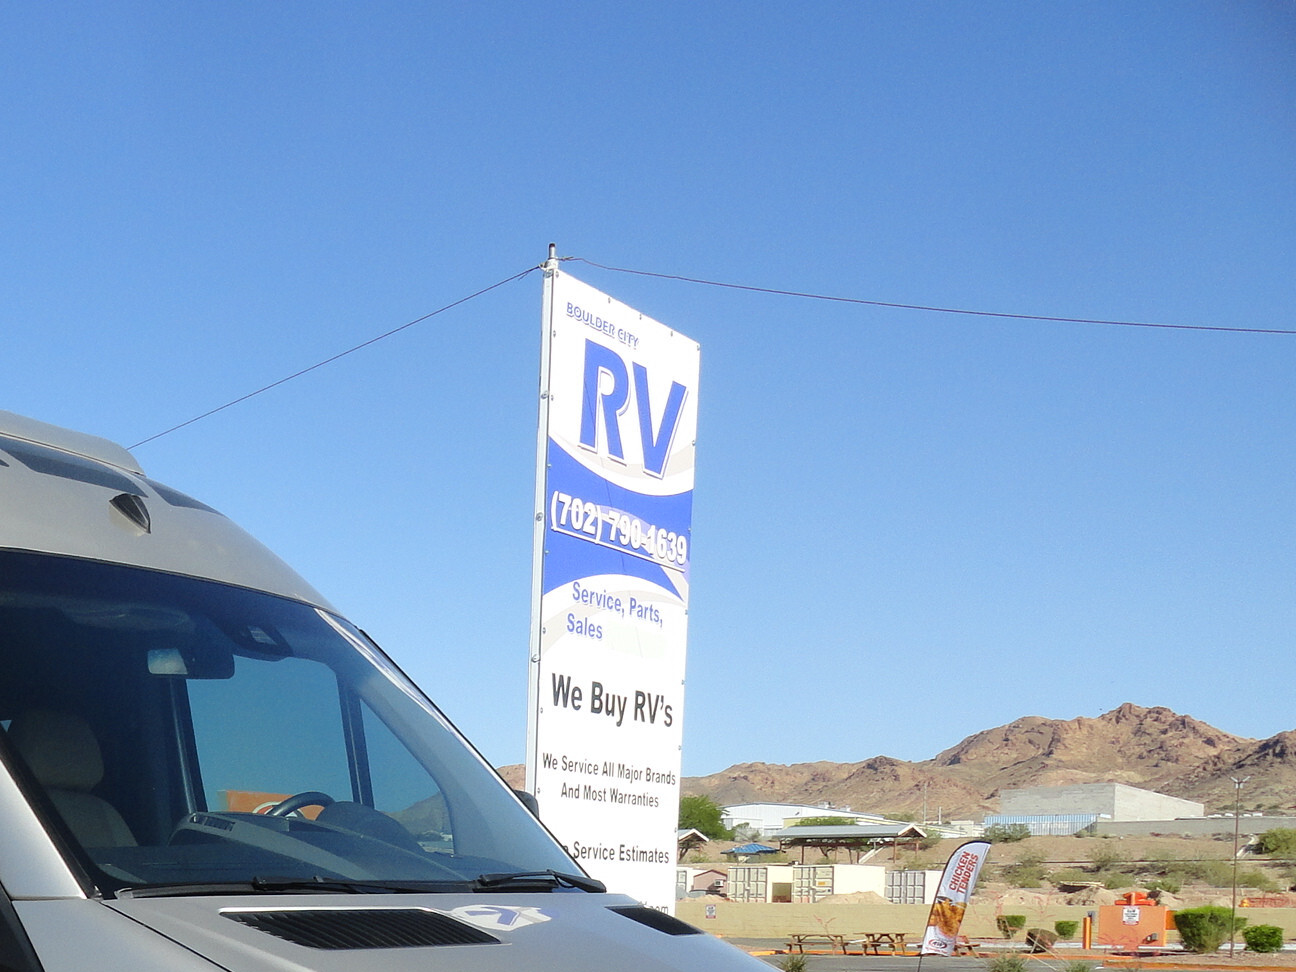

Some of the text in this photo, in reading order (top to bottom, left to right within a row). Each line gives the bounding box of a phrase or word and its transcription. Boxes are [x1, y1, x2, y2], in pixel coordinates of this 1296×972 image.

[566, 301, 639, 347] BOULDER CITY
[579, 337, 688, 480] RV
[551, 490, 687, 565] (702) 790-1639
[572, 581, 663, 628] Service, Parts,
[567, 612, 603, 639] Sales
[552, 672, 673, 728] We Buy RV's
[542, 752, 676, 786] We Service All Major Brands
[561, 782, 659, 808] And Most Warranties
[572, 841, 615, 860] Service
[619, 844, 670, 864] Estimates
[948, 851, 971, 891] CHICKEN
[956, 854, 980, 894] TENDERS
